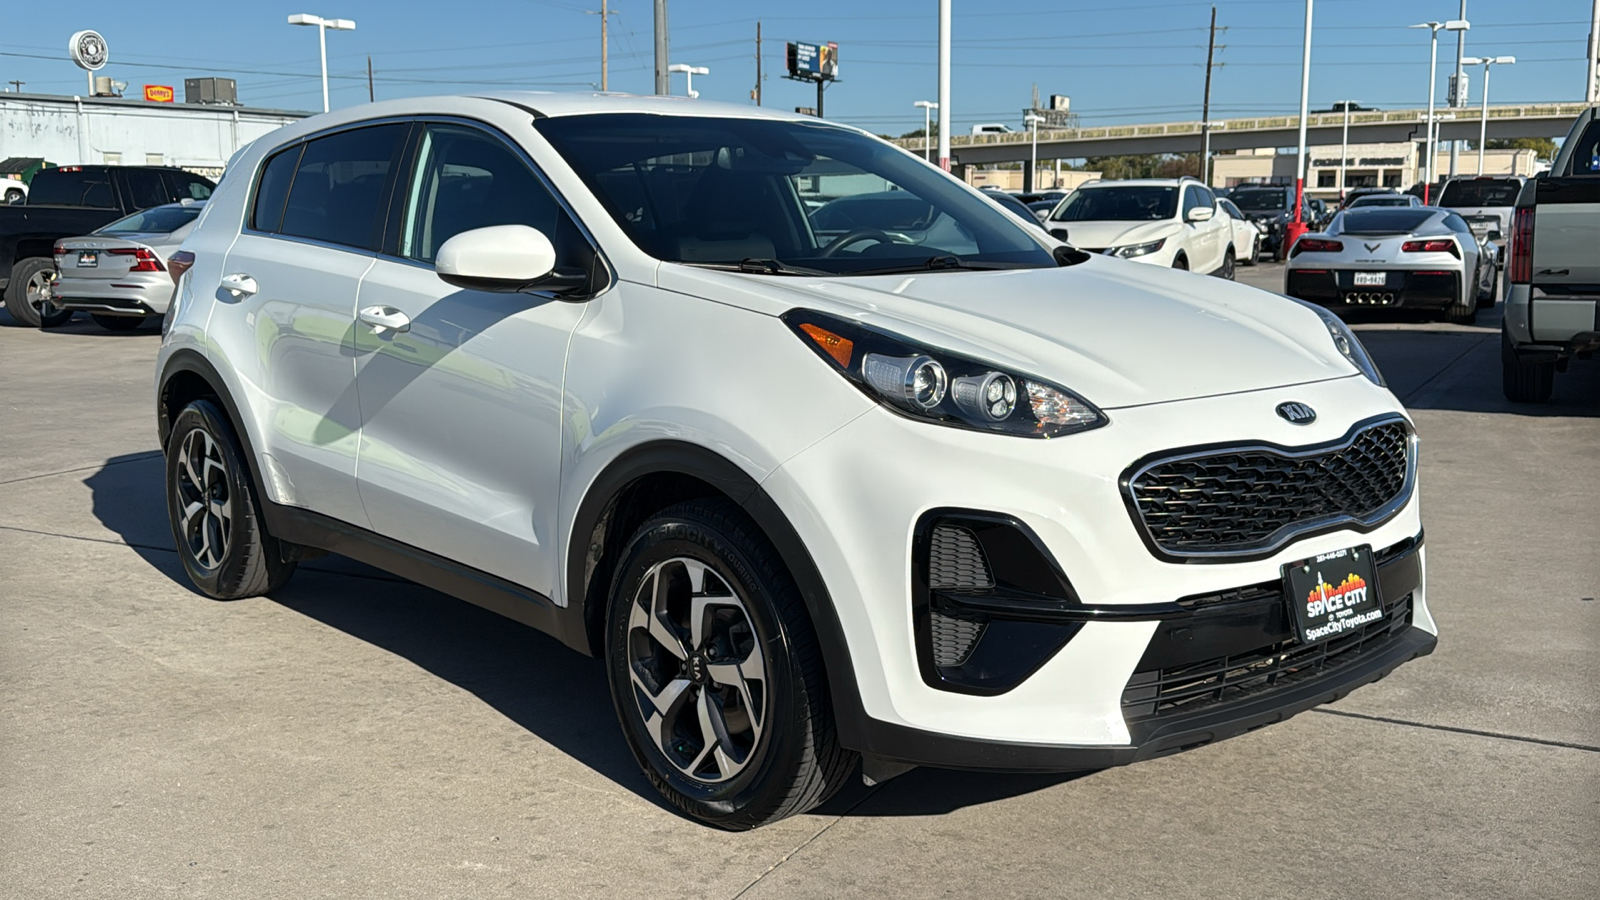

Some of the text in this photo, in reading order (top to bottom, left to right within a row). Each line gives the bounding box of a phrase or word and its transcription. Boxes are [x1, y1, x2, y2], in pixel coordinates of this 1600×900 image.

[1280, 403, 1315, 421] KIA
[723, 548, 758, 593] TOURING
[1306, 586, 1367, 618] SPACE CITY
[1335, 608, 1353, 619] TOYOTA
[1305, 609, 1383, 641] SpaceCityToyota.com
[692, 656, 702, 680] KIA
